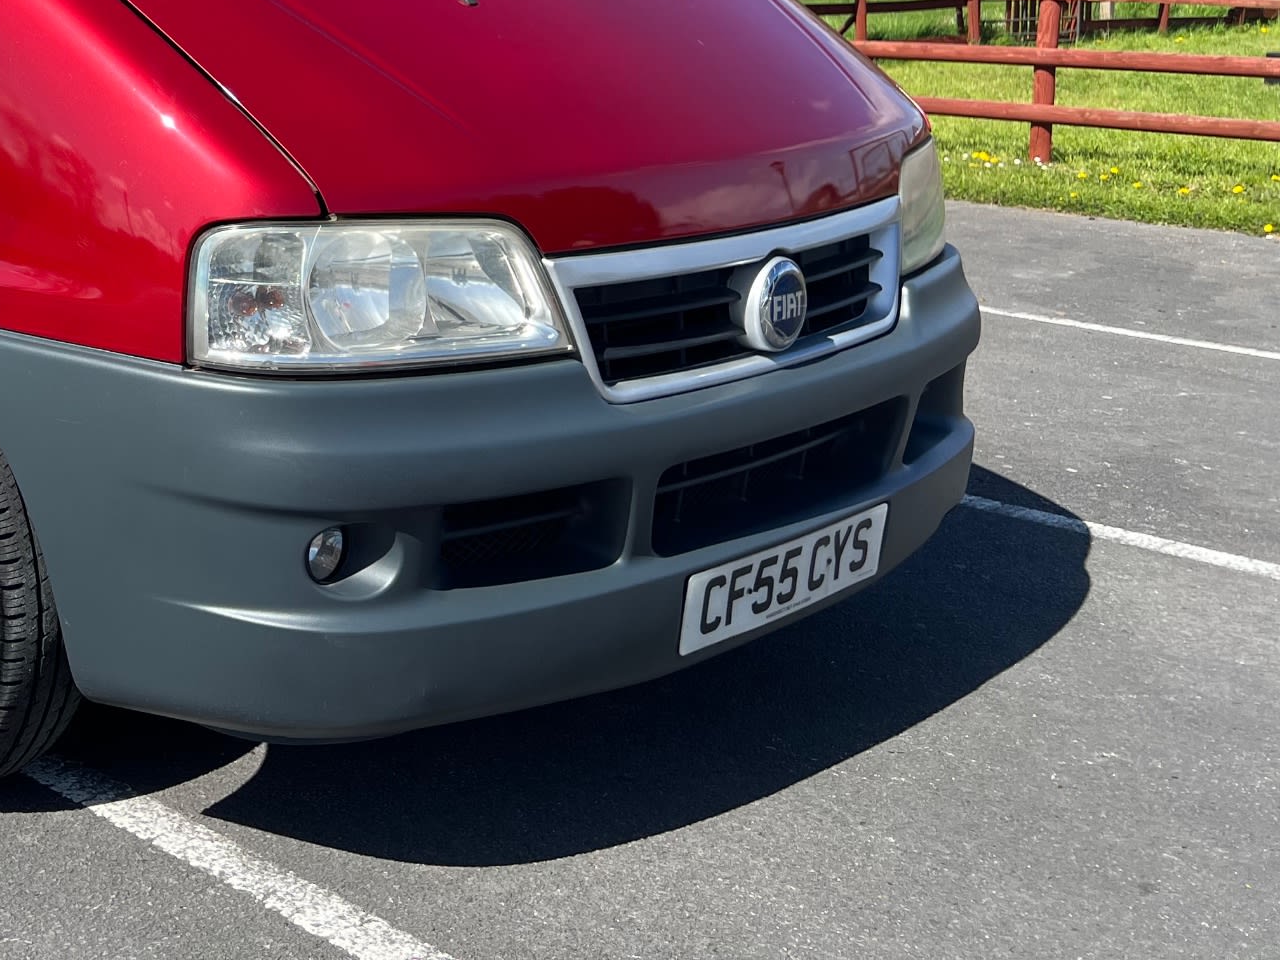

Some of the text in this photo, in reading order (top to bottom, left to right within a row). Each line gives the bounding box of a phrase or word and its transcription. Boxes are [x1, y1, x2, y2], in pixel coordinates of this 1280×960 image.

[773, 290, 803, 322] FIAT
[699, 518, 873, 635] CF55 CYS
